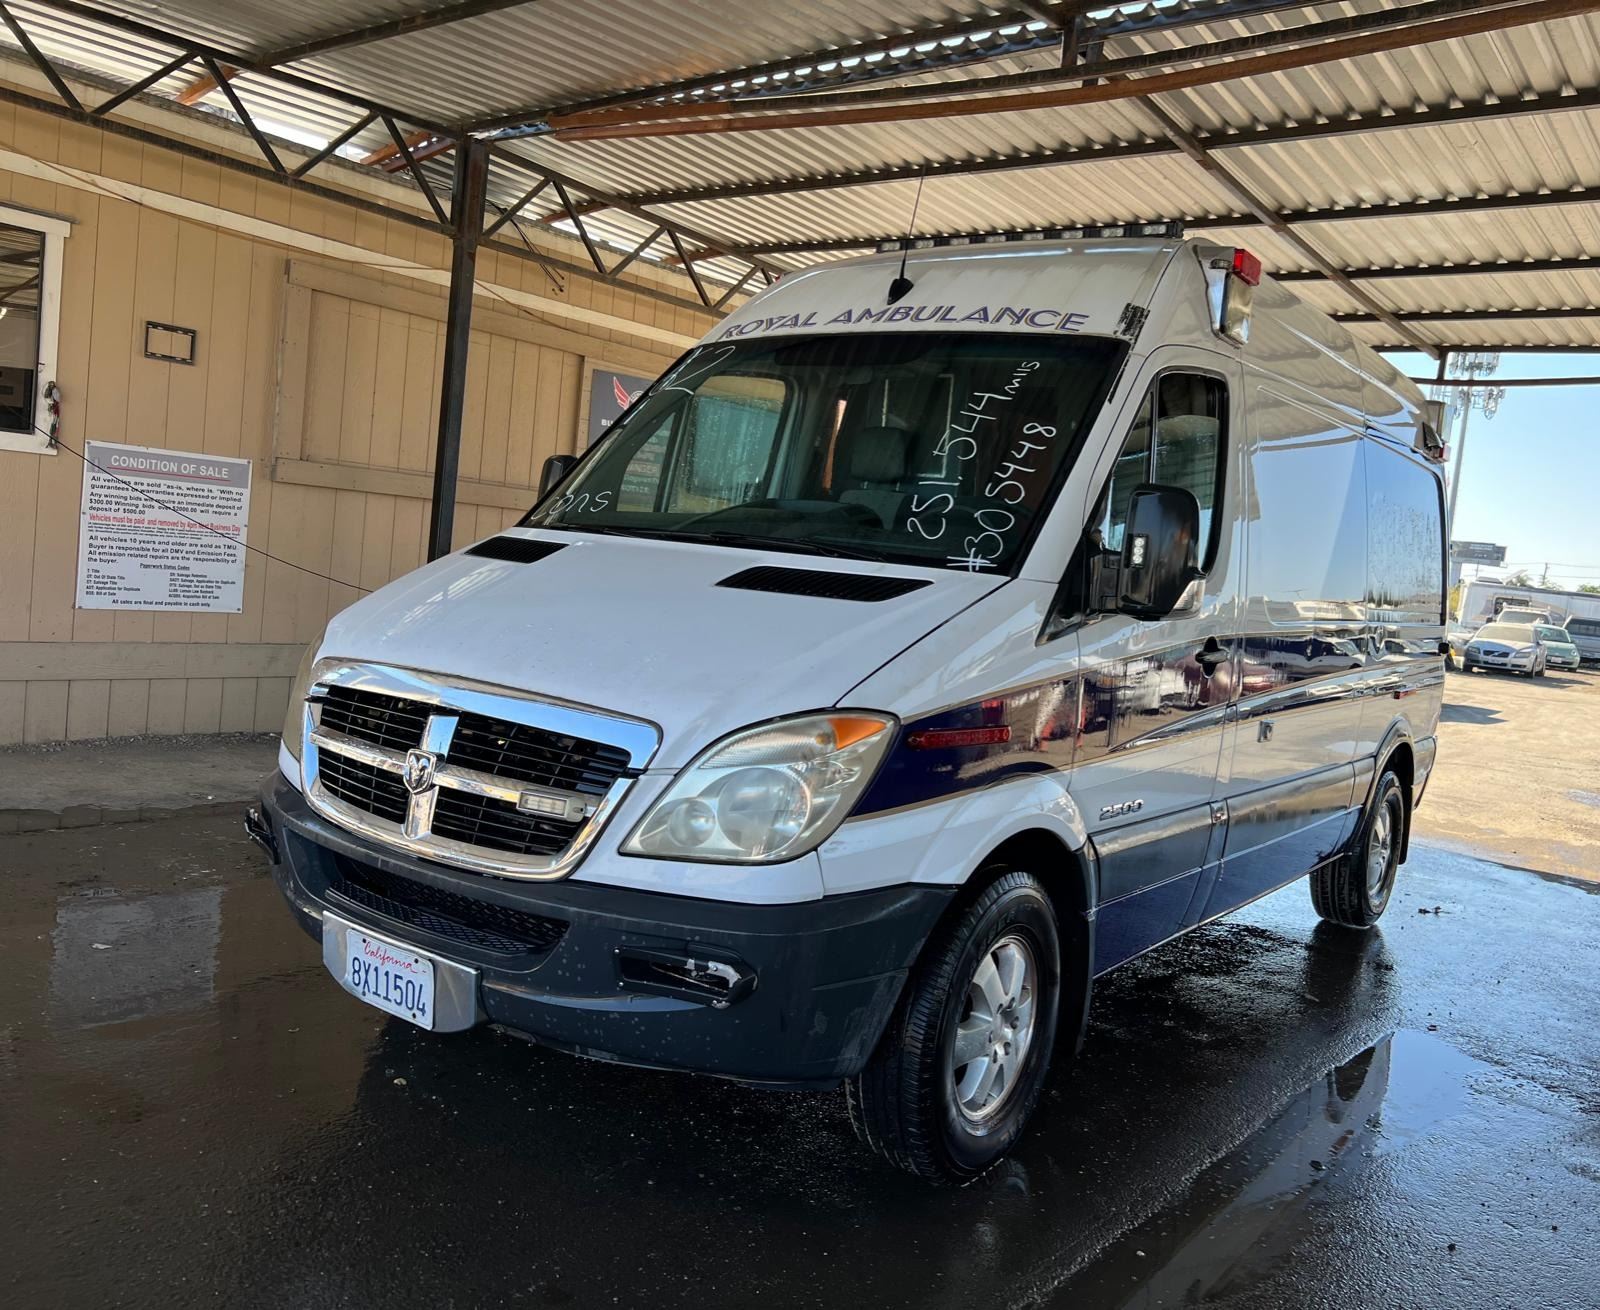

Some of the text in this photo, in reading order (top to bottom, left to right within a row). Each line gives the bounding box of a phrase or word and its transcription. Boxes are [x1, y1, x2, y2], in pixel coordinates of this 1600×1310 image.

[722, 304, 1090, 341] ROYAL AMBULANCE
[111, 456, 229, 478] CONDITION OF SALE
[91, 484, 130, 492] guarantees
[140, 488, 175, 496] warranties
[176, 492, 209, 500] expressed
[104, 493, 128, 501] winning
[946, 422, 1057, 573] #305448
[89, 498, 113, 506] $300.00
[115, 501, 139, 509] Winning
[89, 505, 112, 513] deposit
[88, 543, 107, 551] Buyer
[115, 545, 151, 553] responsible
[1099, 799, 1145, 821] 2500
[364, 941, 418, 973] California
[351, 956, 427, 1018] 8X11504
